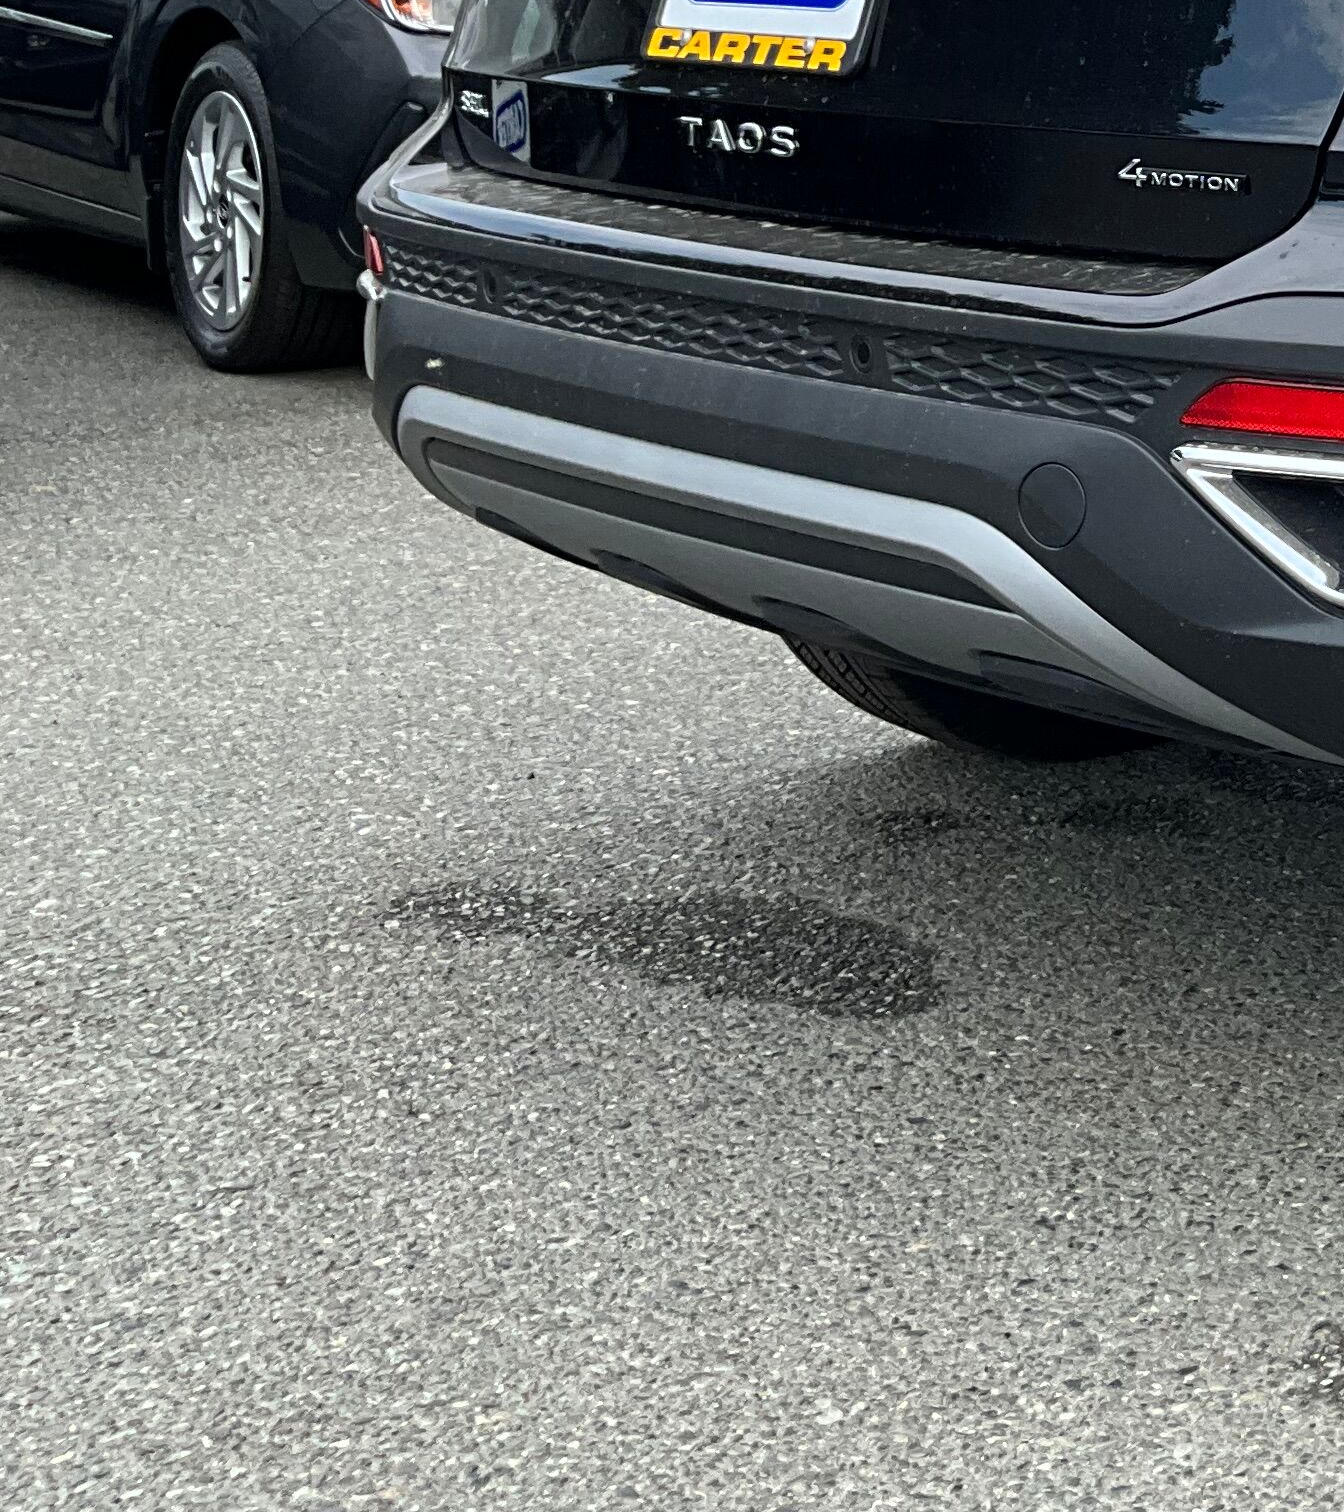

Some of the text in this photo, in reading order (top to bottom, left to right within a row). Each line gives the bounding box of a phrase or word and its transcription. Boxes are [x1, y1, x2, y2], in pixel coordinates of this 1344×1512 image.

[647, 27, 847, 72] CARTER
[679, 116, 797, 158] TAOS
[1117, 158, 1240, 192] 4MOTION
